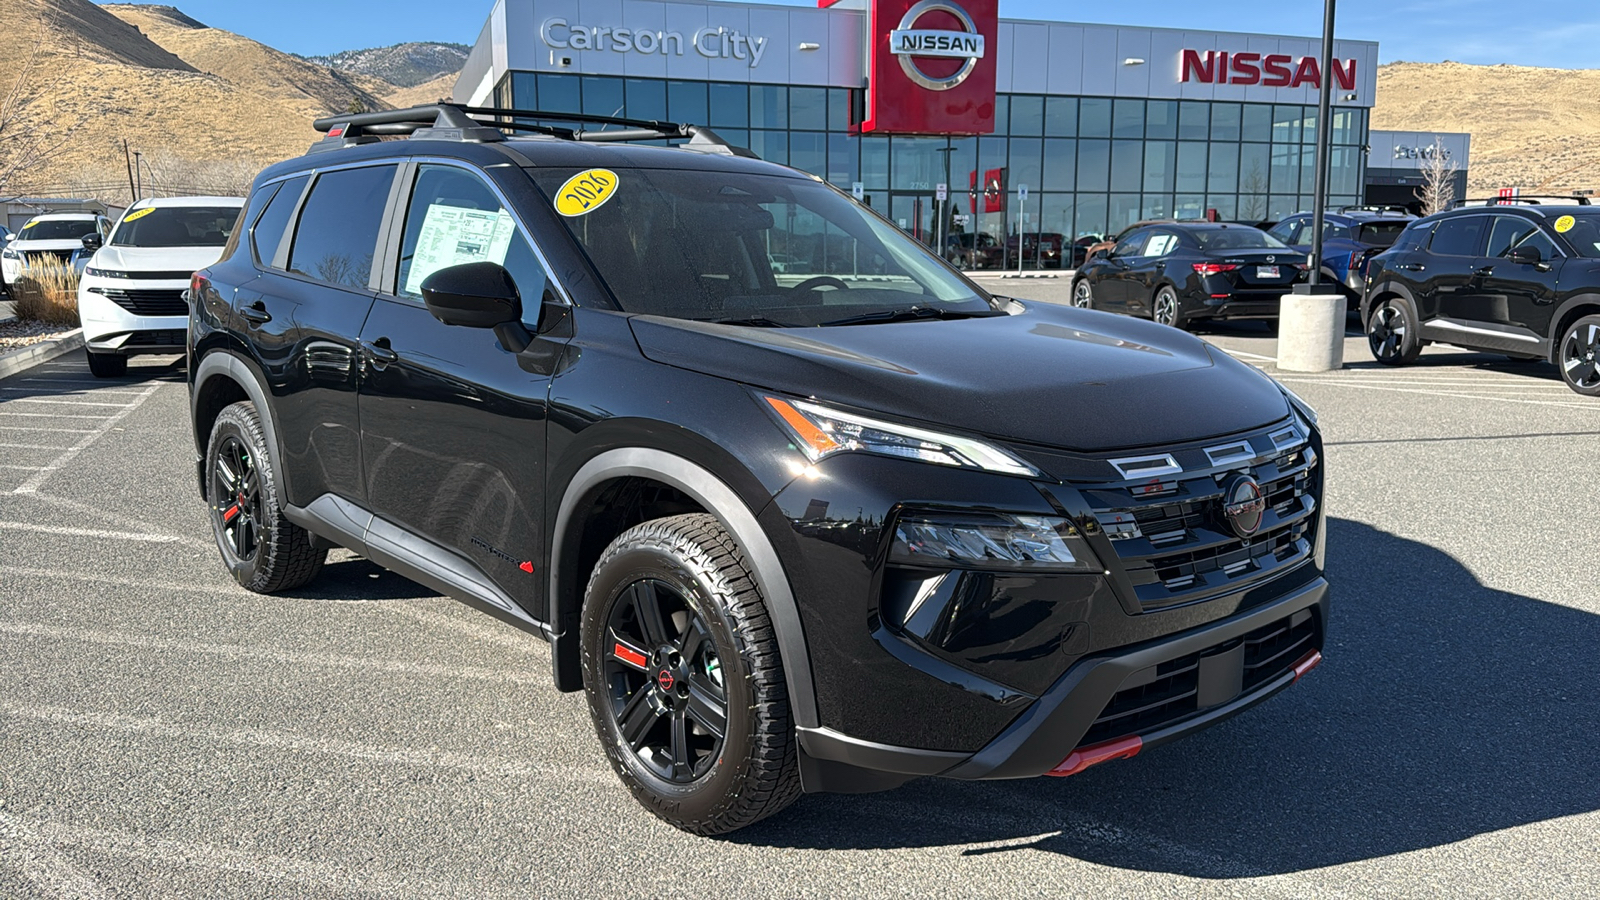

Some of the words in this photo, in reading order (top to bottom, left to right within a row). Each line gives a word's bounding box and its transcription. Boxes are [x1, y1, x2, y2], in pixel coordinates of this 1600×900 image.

[540, 17, 684, 55] Carson
[693, 26, 769, 68] City
[902, 35, 977, 52] NISSAN
[1181, 49, 1357, 90] NISSAN
[566, 172, 610, 209] 2026
[910, 182, 929, 190] 2750
